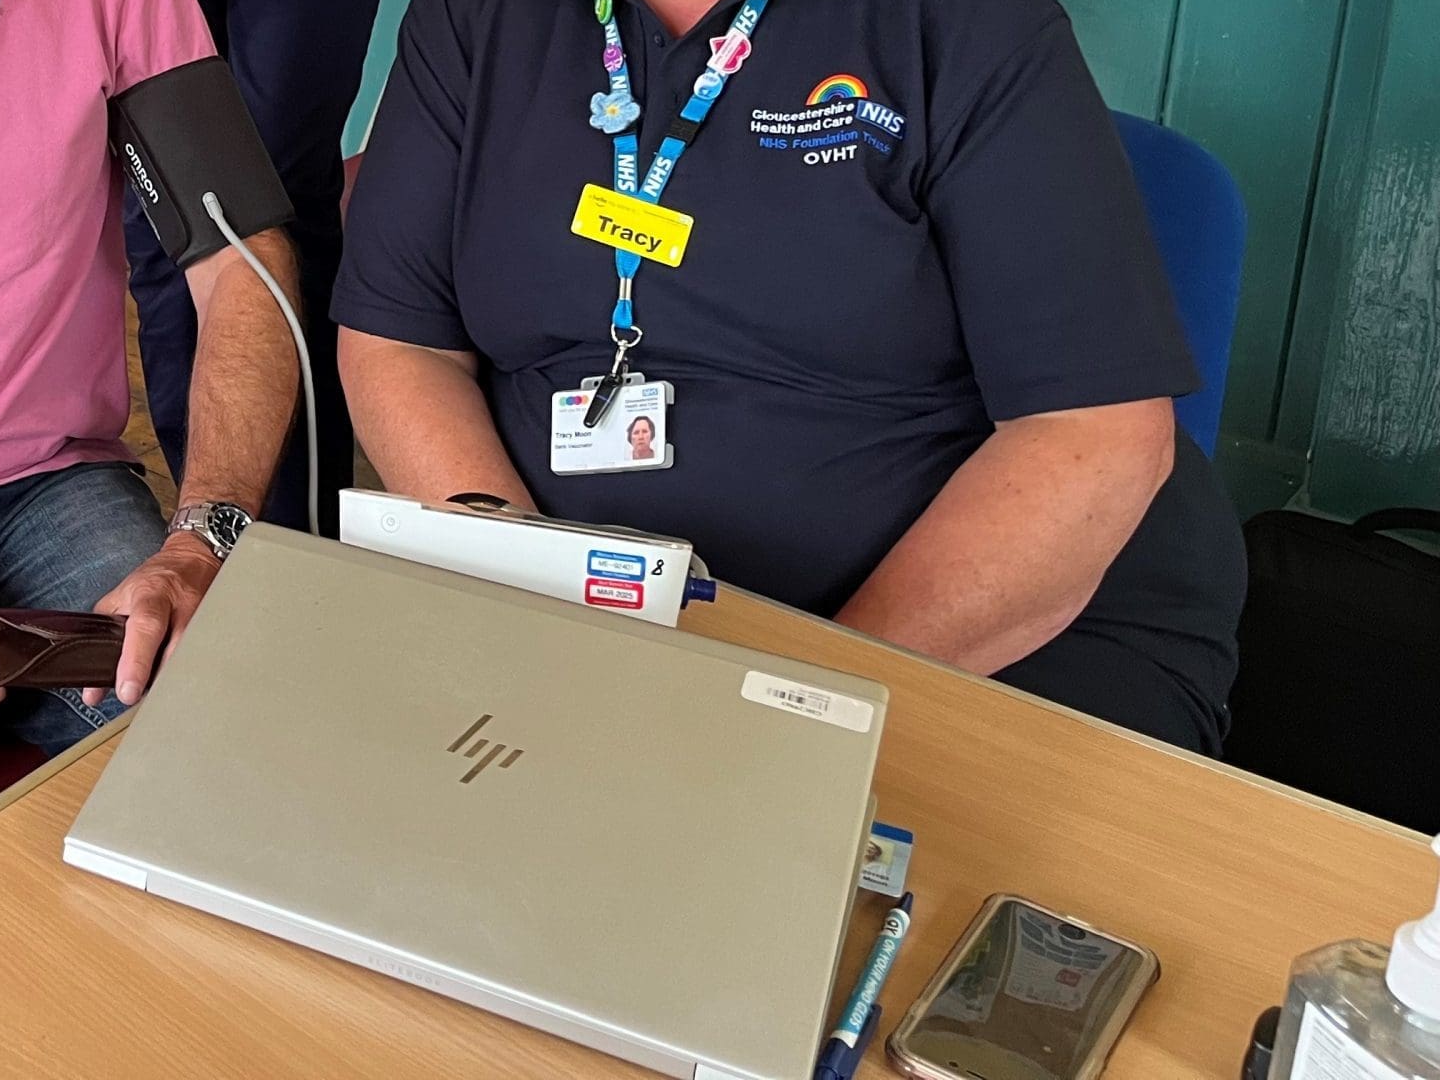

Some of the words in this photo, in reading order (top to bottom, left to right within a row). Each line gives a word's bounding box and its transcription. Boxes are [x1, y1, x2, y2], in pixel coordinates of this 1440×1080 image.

[750, 120, 795, 134] Health
[797, 120, 821, 134] and
[823, 115, 853, 129] Care
[752, 101, 855, 122] Gloucestershire
[861, 102, 905, 134] NHS
[760, 137, 787, 149] NHS
[792, 130, 858, 149] Foundation
[862, 131, 892, 155] Trust
[803, 145, 858, 165] OVHT
[125, 143, 160, 205] OMRON
[617, 154, 636, 192] NHS
[643, 156, 671, 197] NHS
[598, 214, 662, 253] Tracy
[555, 431, 573, 440] Tracy
[651, 559, 664, 575] 8
[596, 587, 614, 596] MAR
[615, 590, 633, 599] 2025
[871, 953, 891, 980] YOUR
[861, 976, 879, 1003] MIND
[850, 1001, 868, 1028] GLOS
